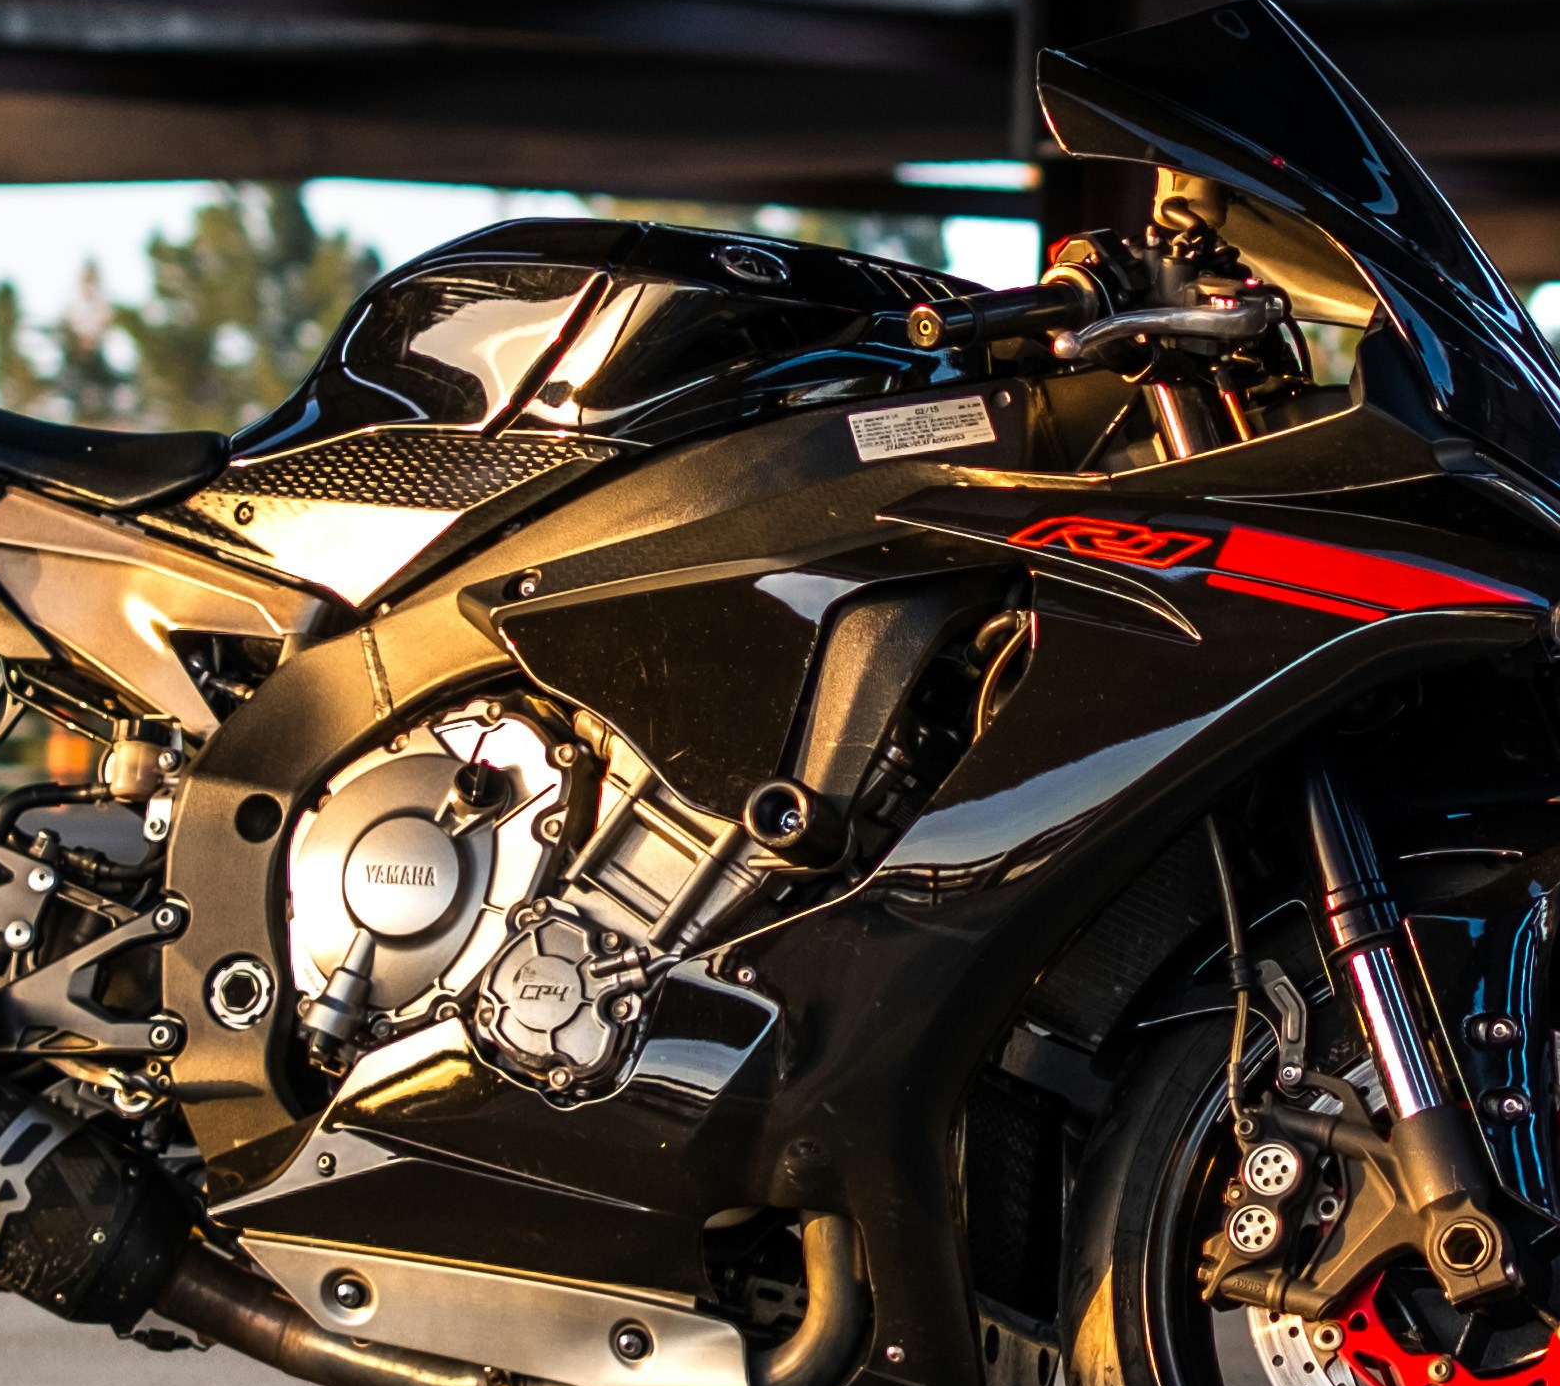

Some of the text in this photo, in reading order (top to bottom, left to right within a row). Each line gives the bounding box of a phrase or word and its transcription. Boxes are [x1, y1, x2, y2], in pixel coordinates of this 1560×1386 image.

[1007, 515, 1212, 569] R1
[365, 864, 438, 886] YAMAHA
[519, 984, 569, 1002] CP4
